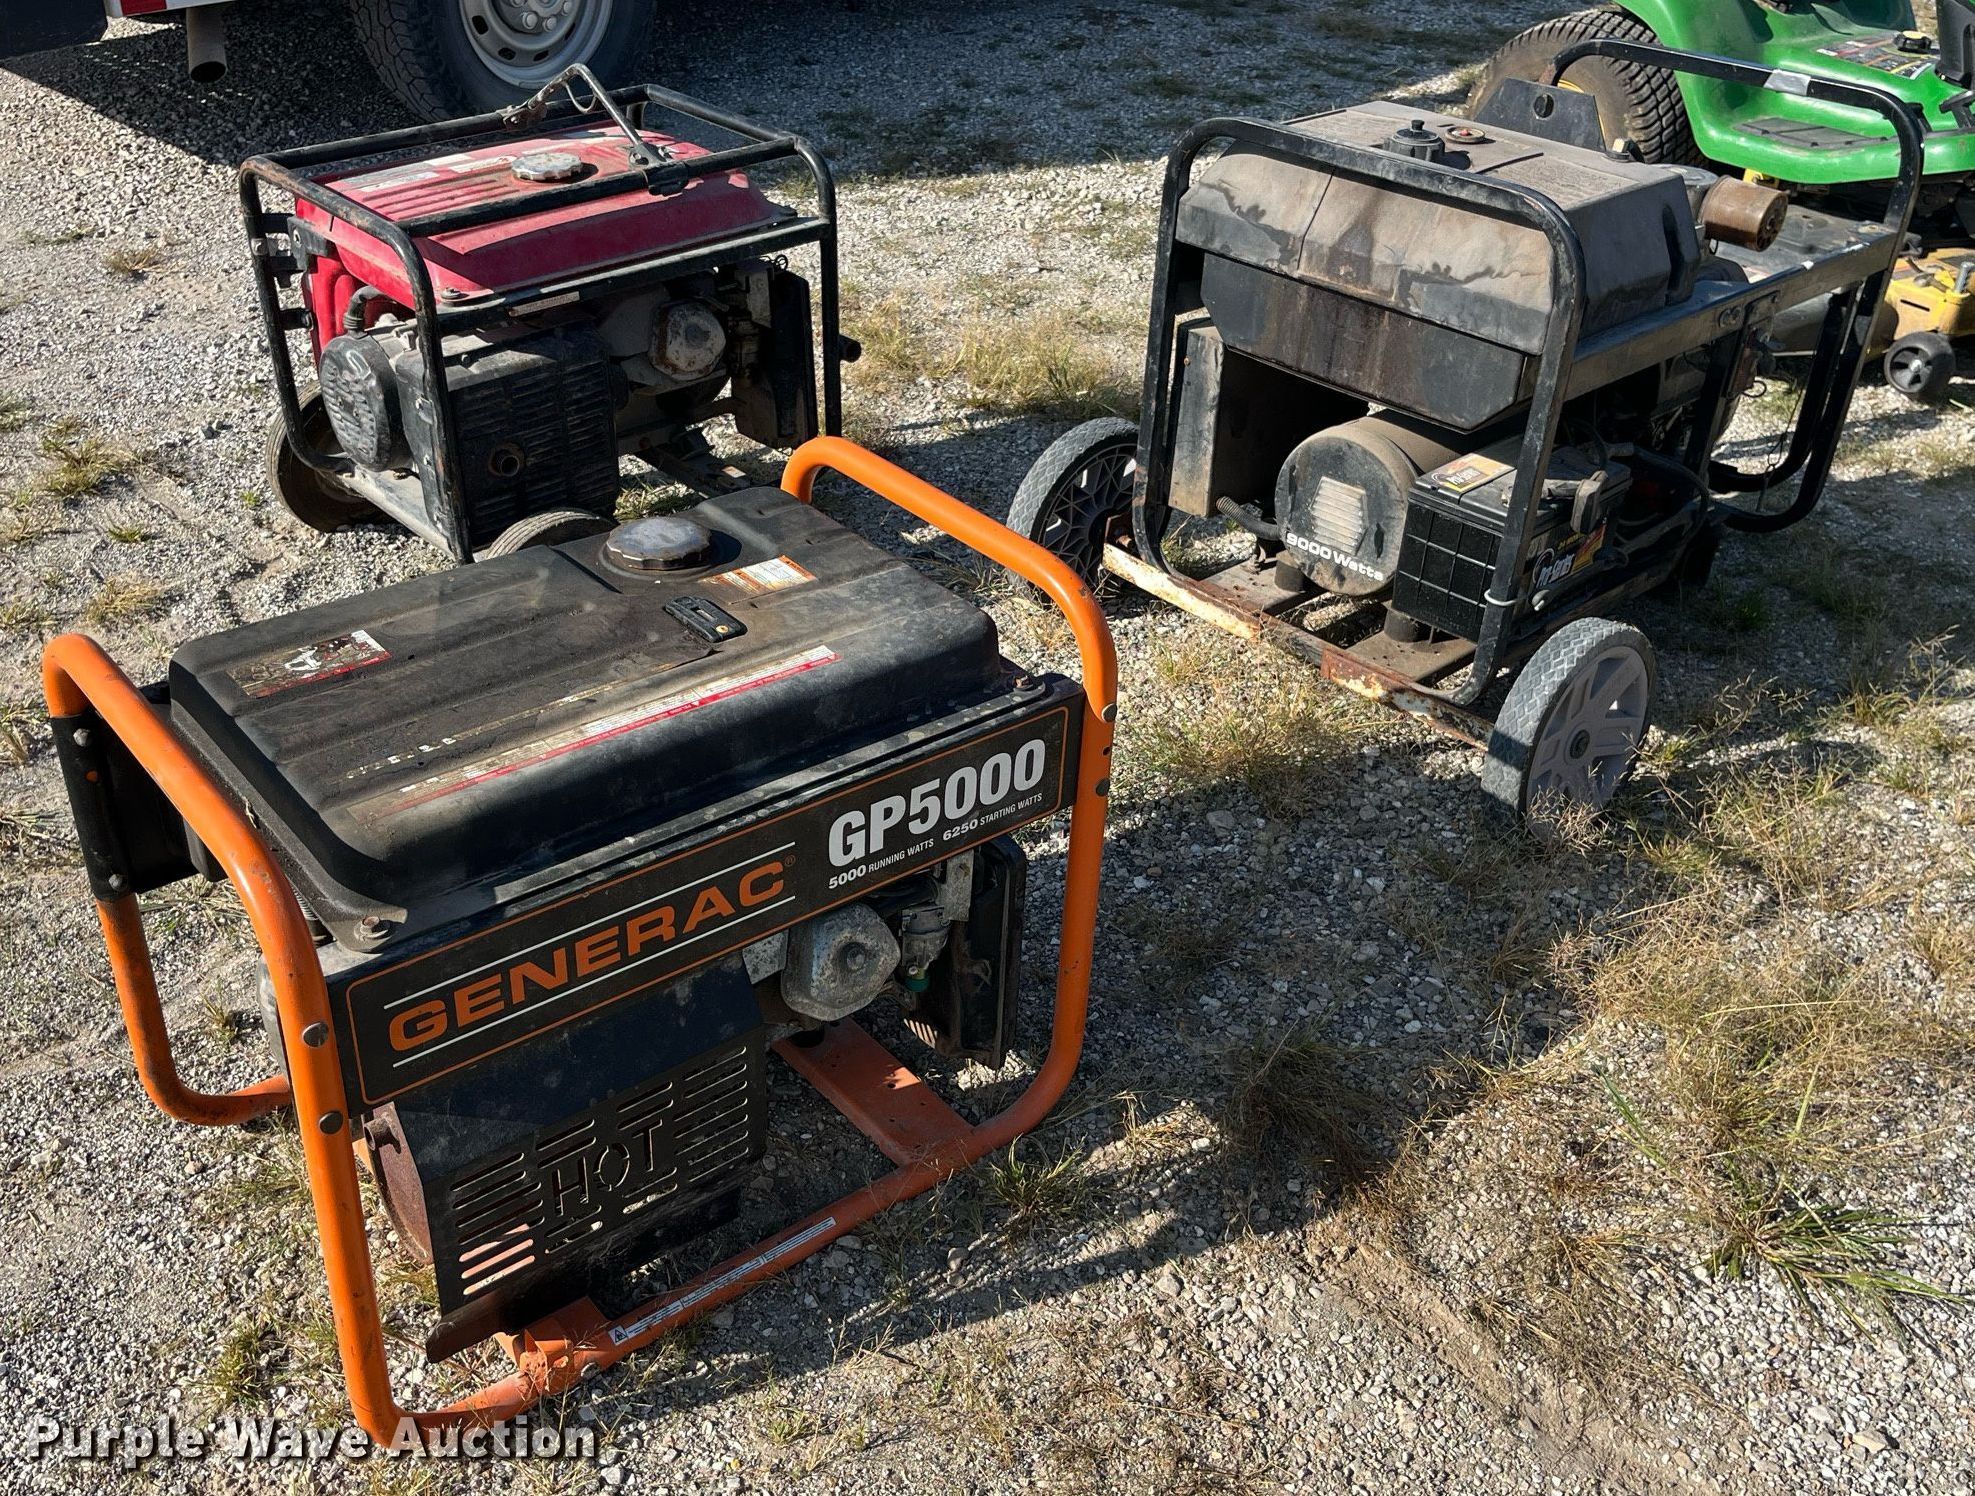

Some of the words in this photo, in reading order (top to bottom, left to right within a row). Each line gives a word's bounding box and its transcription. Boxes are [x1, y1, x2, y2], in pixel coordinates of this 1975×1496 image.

[828, 738, 1046, 867] GP5000
[828, 864, 867, 890] 5000
[868, 850, 906, 873] RUNNING
[907, 838, 935, 856] WATTS
[942, 818, 979, 842] 6250
[979, 804, 1016, 826] STARTING
[1017, 792, 1043, 810] WATTS
[388, 861, 785, 1052] GENERAC
[551, 1119, 663, 1218] HOT
